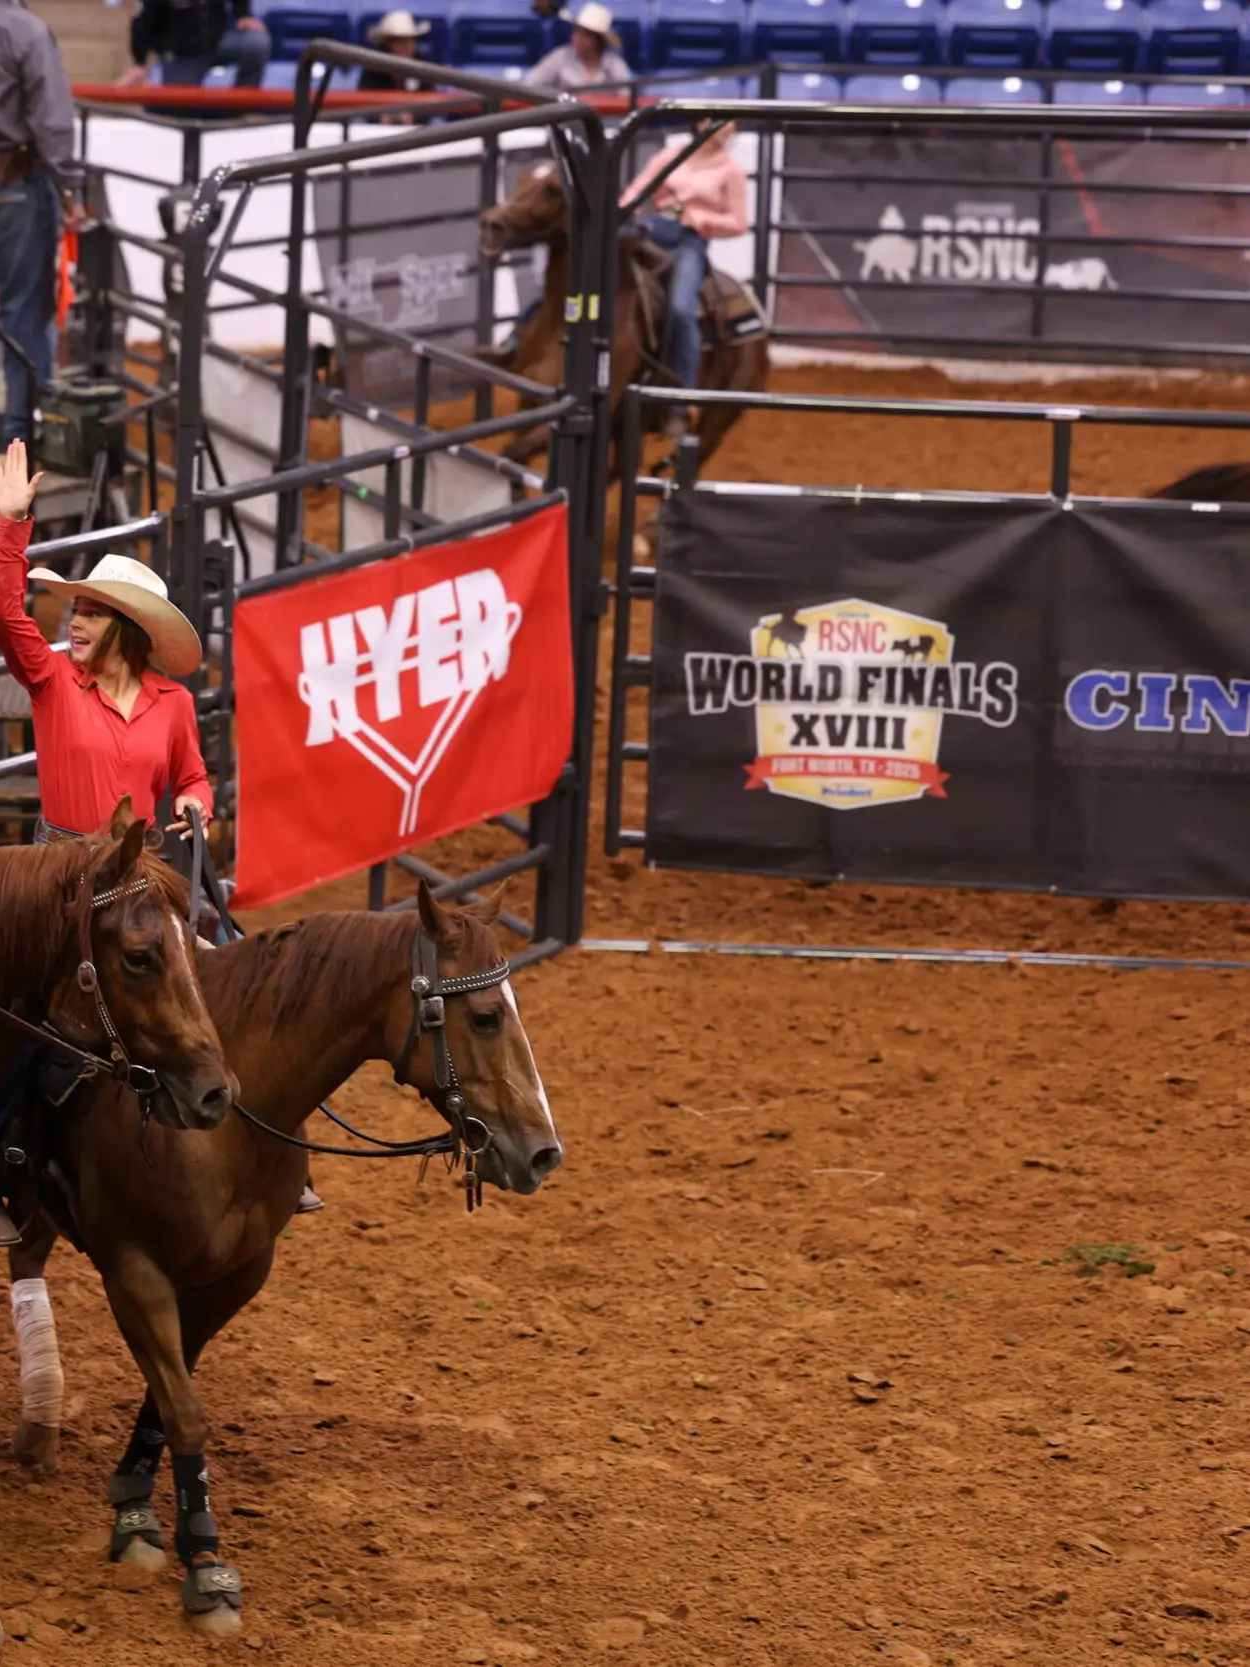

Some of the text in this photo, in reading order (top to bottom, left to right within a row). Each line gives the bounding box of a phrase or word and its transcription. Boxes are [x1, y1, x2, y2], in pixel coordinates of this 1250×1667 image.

[919, 214, 1041, 282] RSNC
[298, 567, 523, 747] HYER
[817, 619, 887, 654] RSNC
[685, 653, 1018, 727] WORLD FINALS
[1064, 669, 1250, 736] CIN
[789, 713, 907, 751] XVIII
